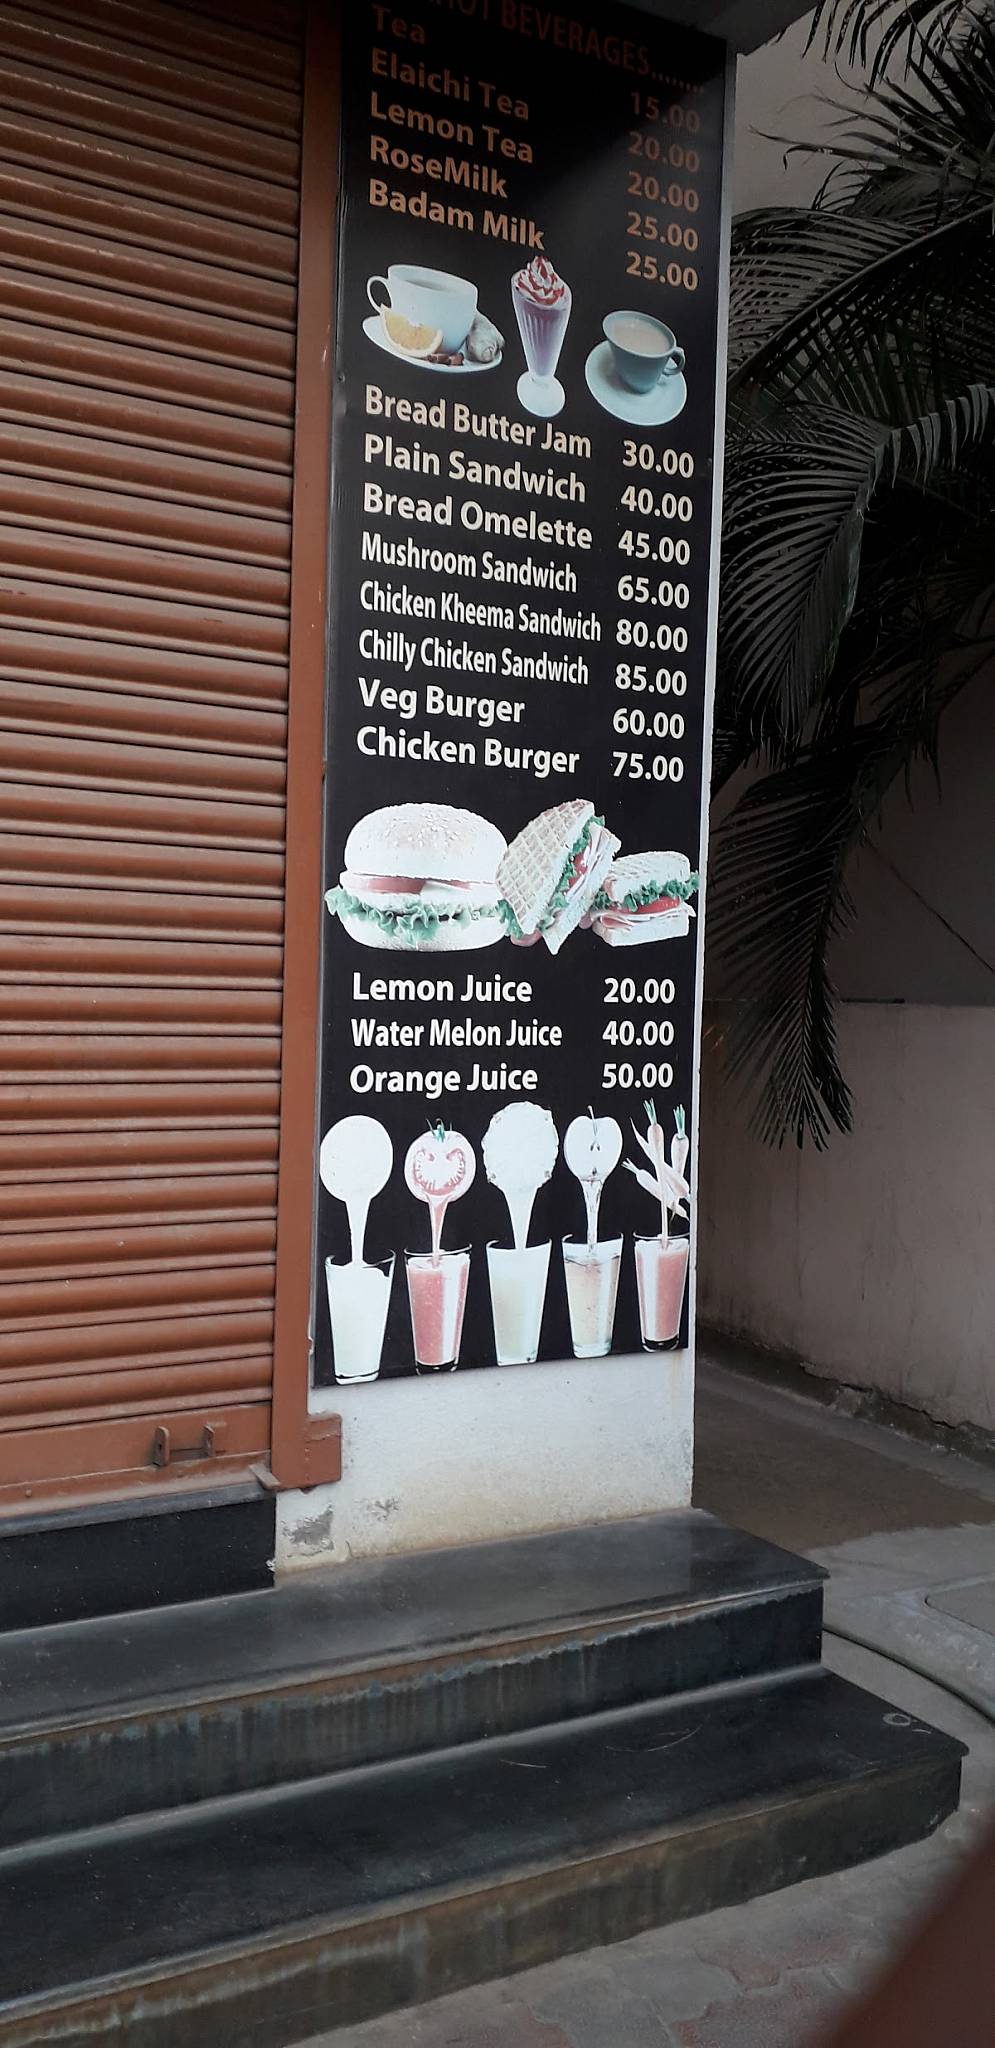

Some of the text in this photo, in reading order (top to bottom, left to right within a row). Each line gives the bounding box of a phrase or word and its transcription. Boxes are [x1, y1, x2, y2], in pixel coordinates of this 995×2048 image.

[373, 4, 700, 132] Tea 15.00
[372, 48, 700, 172] Elaichi Tea 20.00
[371, 91, 699, 212] Lemon Tea 20.00
[370, 135, 699, 251] RoseMilk 25.00
[369, 179, 698, 291] Badam Milk 25.00
[365, 384, 694, 478] Bread Butter Jam 30.00
[364, 433, 693, 522] Plain Sandwich 40.00
[364, 483, 690, 565] Bread Omelette 45.00
[361, 531, 690, 609] Mushroom Sandwich 65.00
[360, 580, 688, 652] Chicken Kheema Sandwich 80.00
[359, 629, 687, 696] Chilly Chicken Sandwich 85.00
[358, 677, 685, 739] Veg Burger 60.00
[356, 726, 684, 782] Chicken Burger 75.00
[352, 973, 675, 1004] Lemon Juice 20.00
[351, 1018, 674, 1046] Water Melon Juice 40.00
[350, 1063, 673, 1100] Orange Juice 50.00
